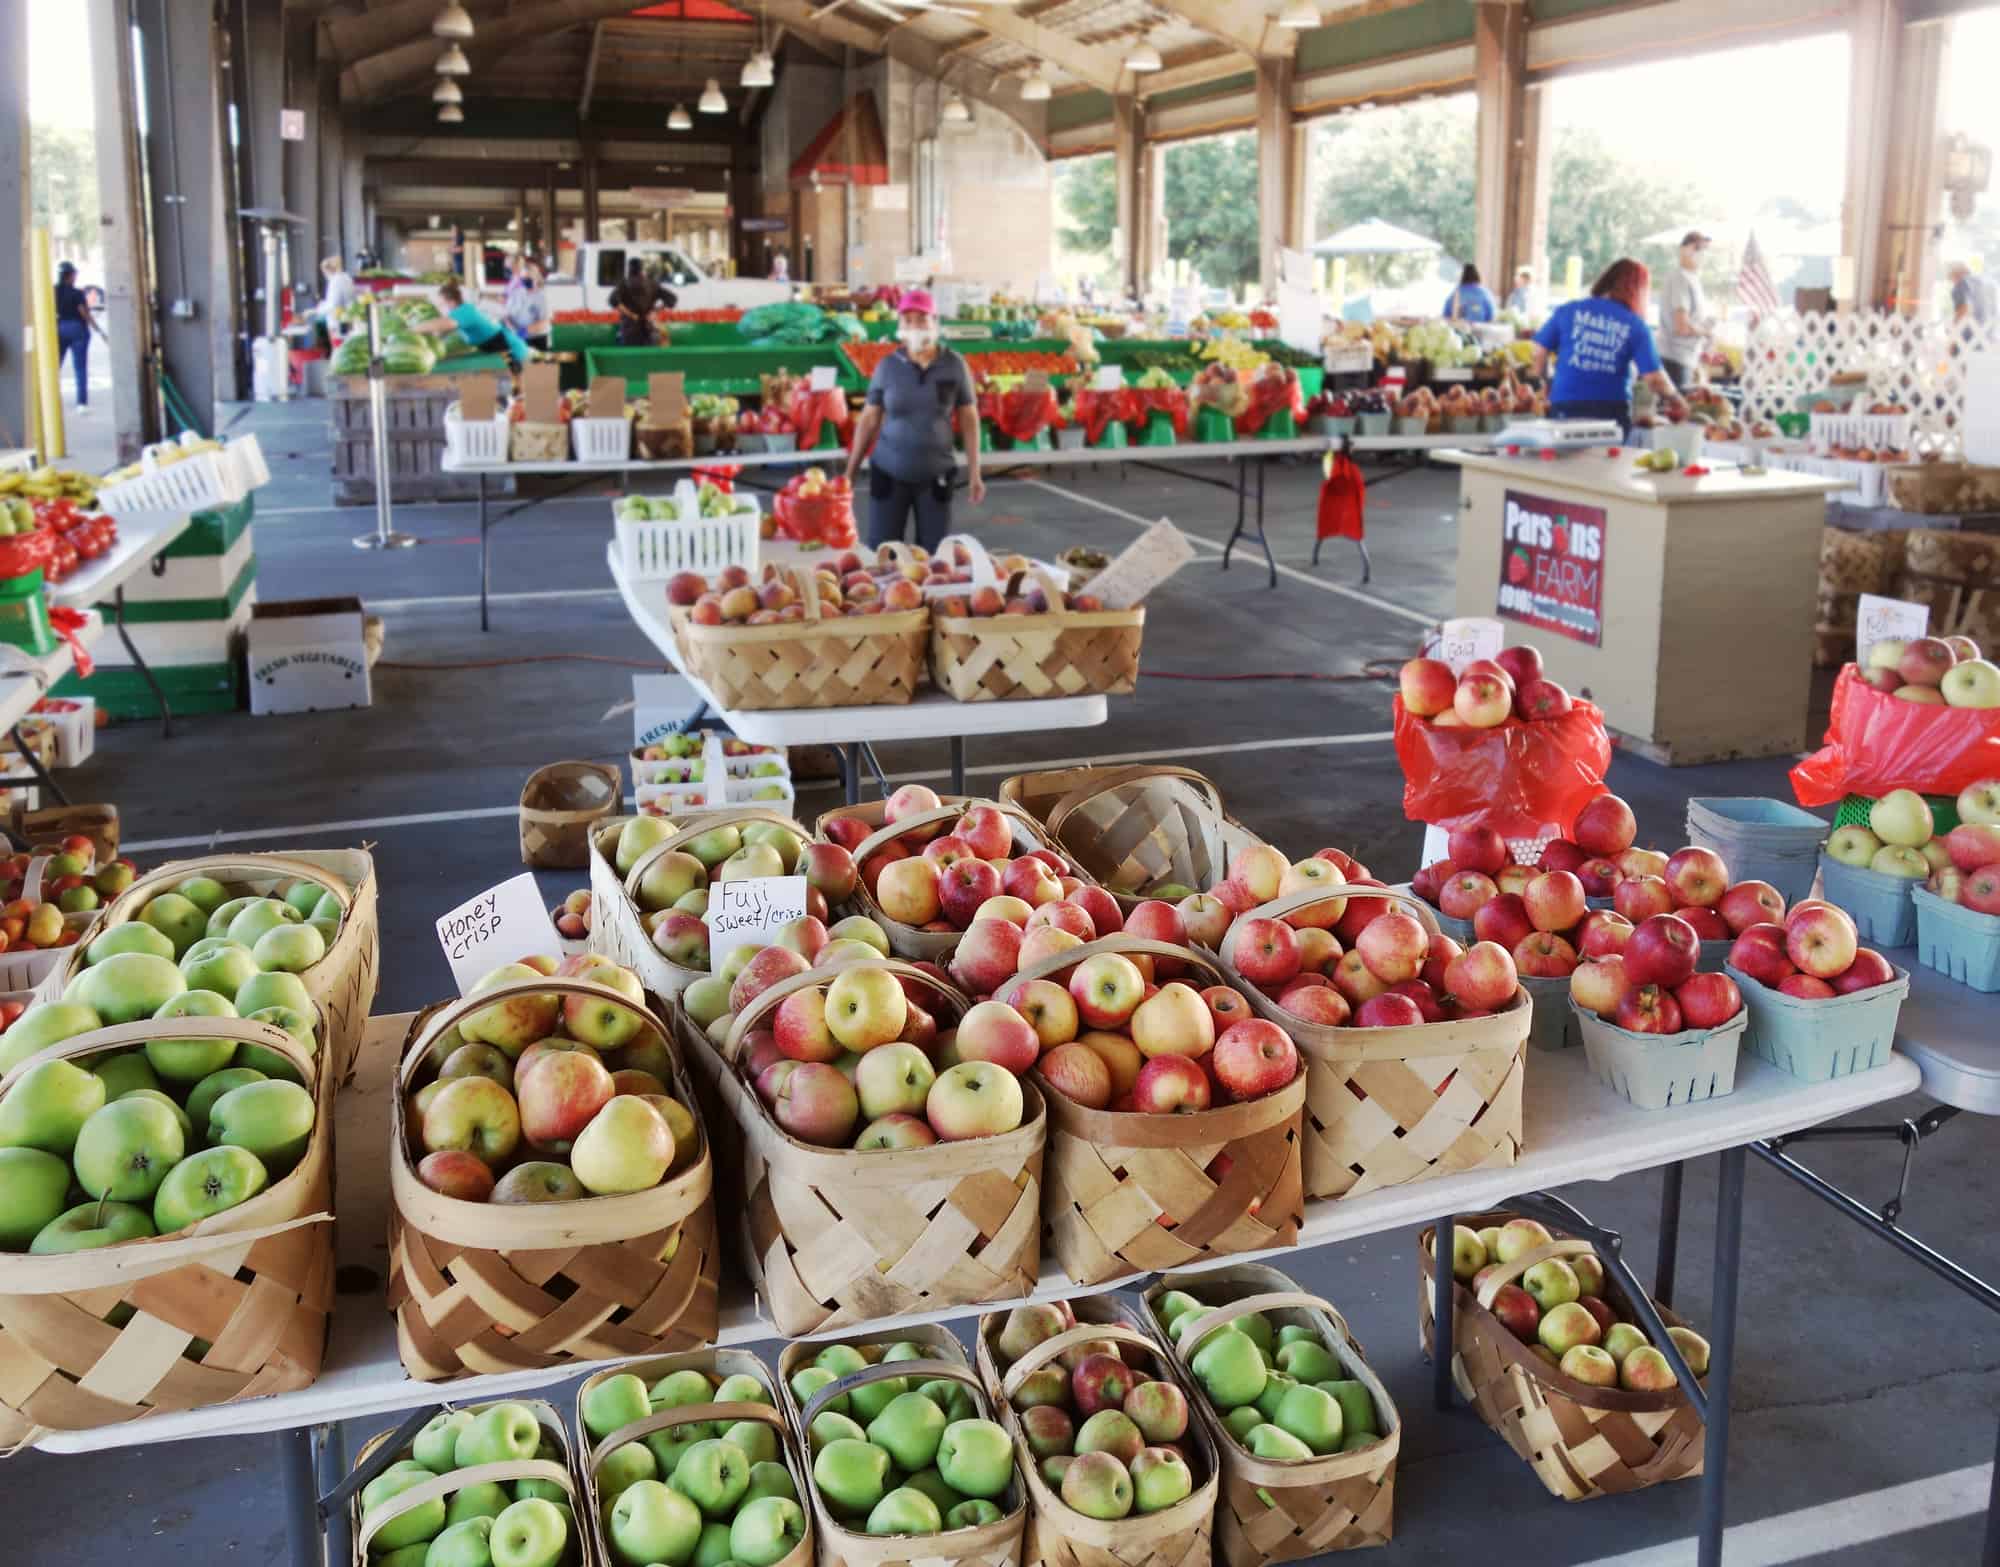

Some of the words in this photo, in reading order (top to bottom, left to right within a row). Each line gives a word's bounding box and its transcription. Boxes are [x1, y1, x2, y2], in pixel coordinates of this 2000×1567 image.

[1570, 325, 1624, 352] Family
[1573, 308, 1631, 339] Making
[1534, 553, 1599, 606] FARM
[255, 656, 289, 681] FRESH
[291, 651, 363, 674] VEGETABLES
[639, 719, 678, 745] FRESH
[722, 880, 768, 914] Fuji
[441, 893, 497, 946] Honey
